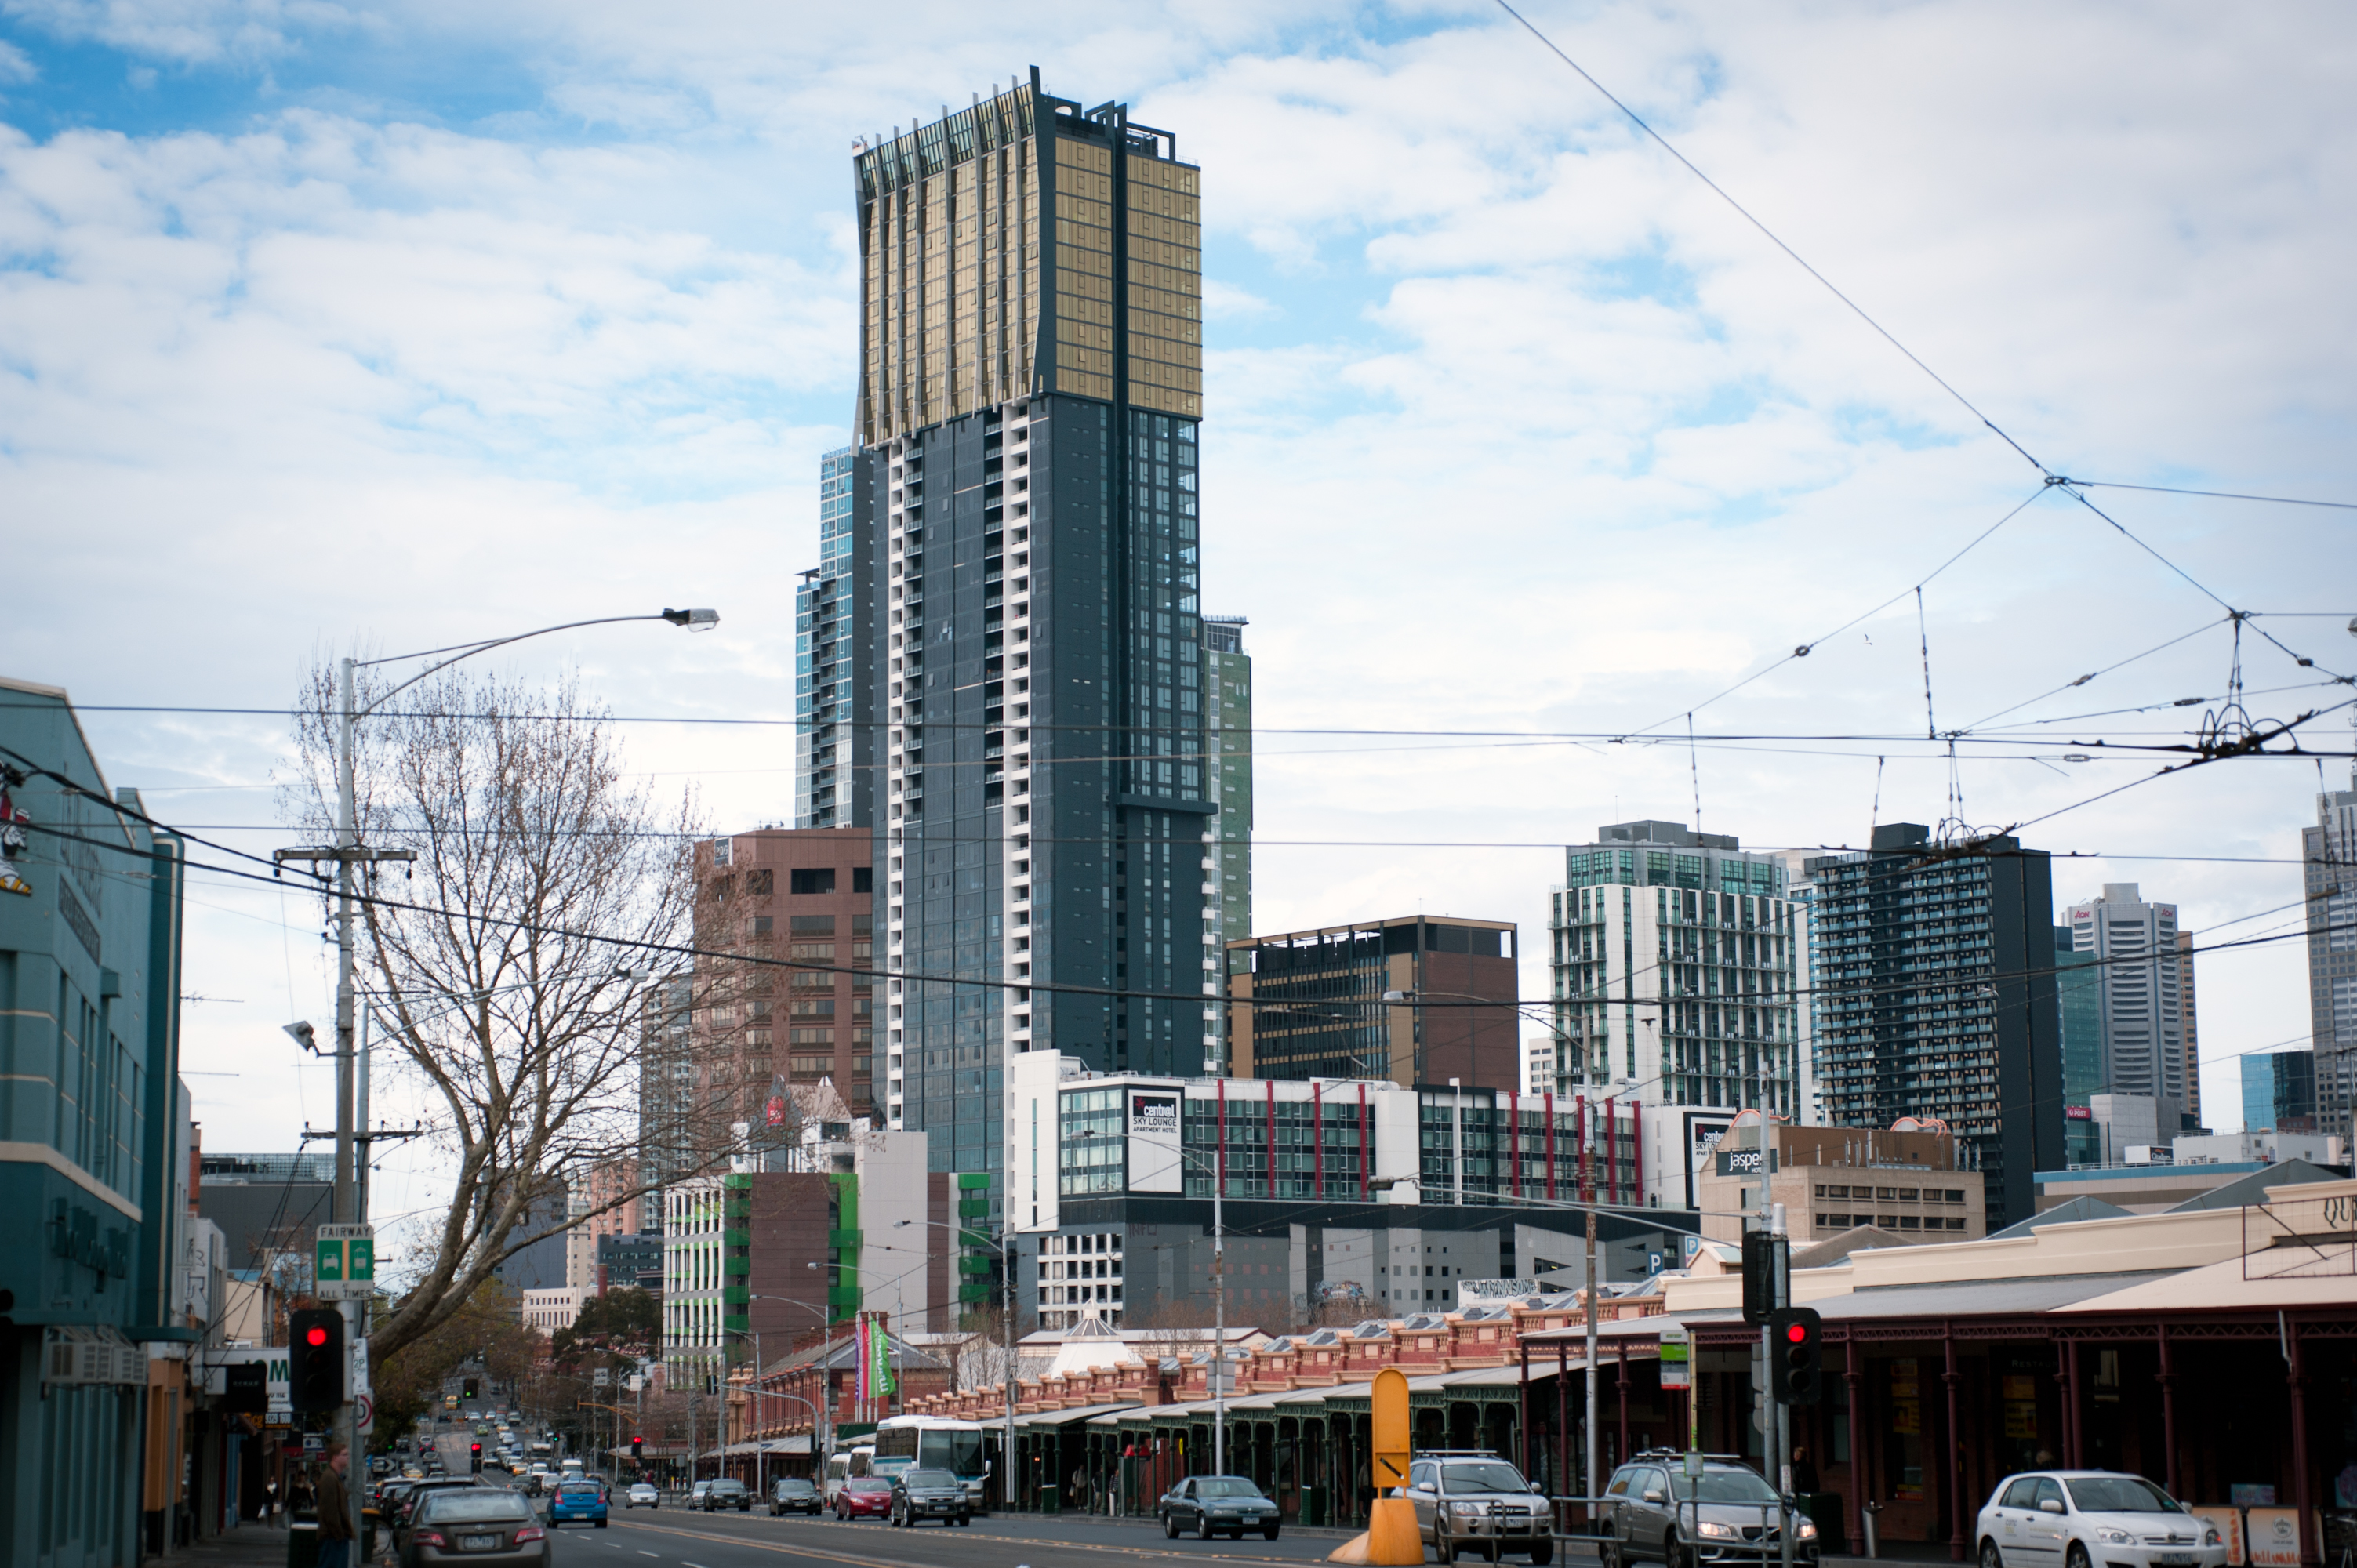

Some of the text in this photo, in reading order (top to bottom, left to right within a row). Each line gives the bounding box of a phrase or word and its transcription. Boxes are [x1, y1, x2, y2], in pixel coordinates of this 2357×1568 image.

[2075, 910, 2090, 919] AON
[1149, 1118, 1177, 1127] LOUNGE
[1704, 1131, 1725, 1142] centr
[1729, 1152, 1761, 1171] jaspe
[321, 1227, 369, 1237] FAIRWAY
[1690, 1240, 1696, 1252] P
[1651, 1254, 1661, 1273] P
[354, 1359, 365, 1368] 2P
